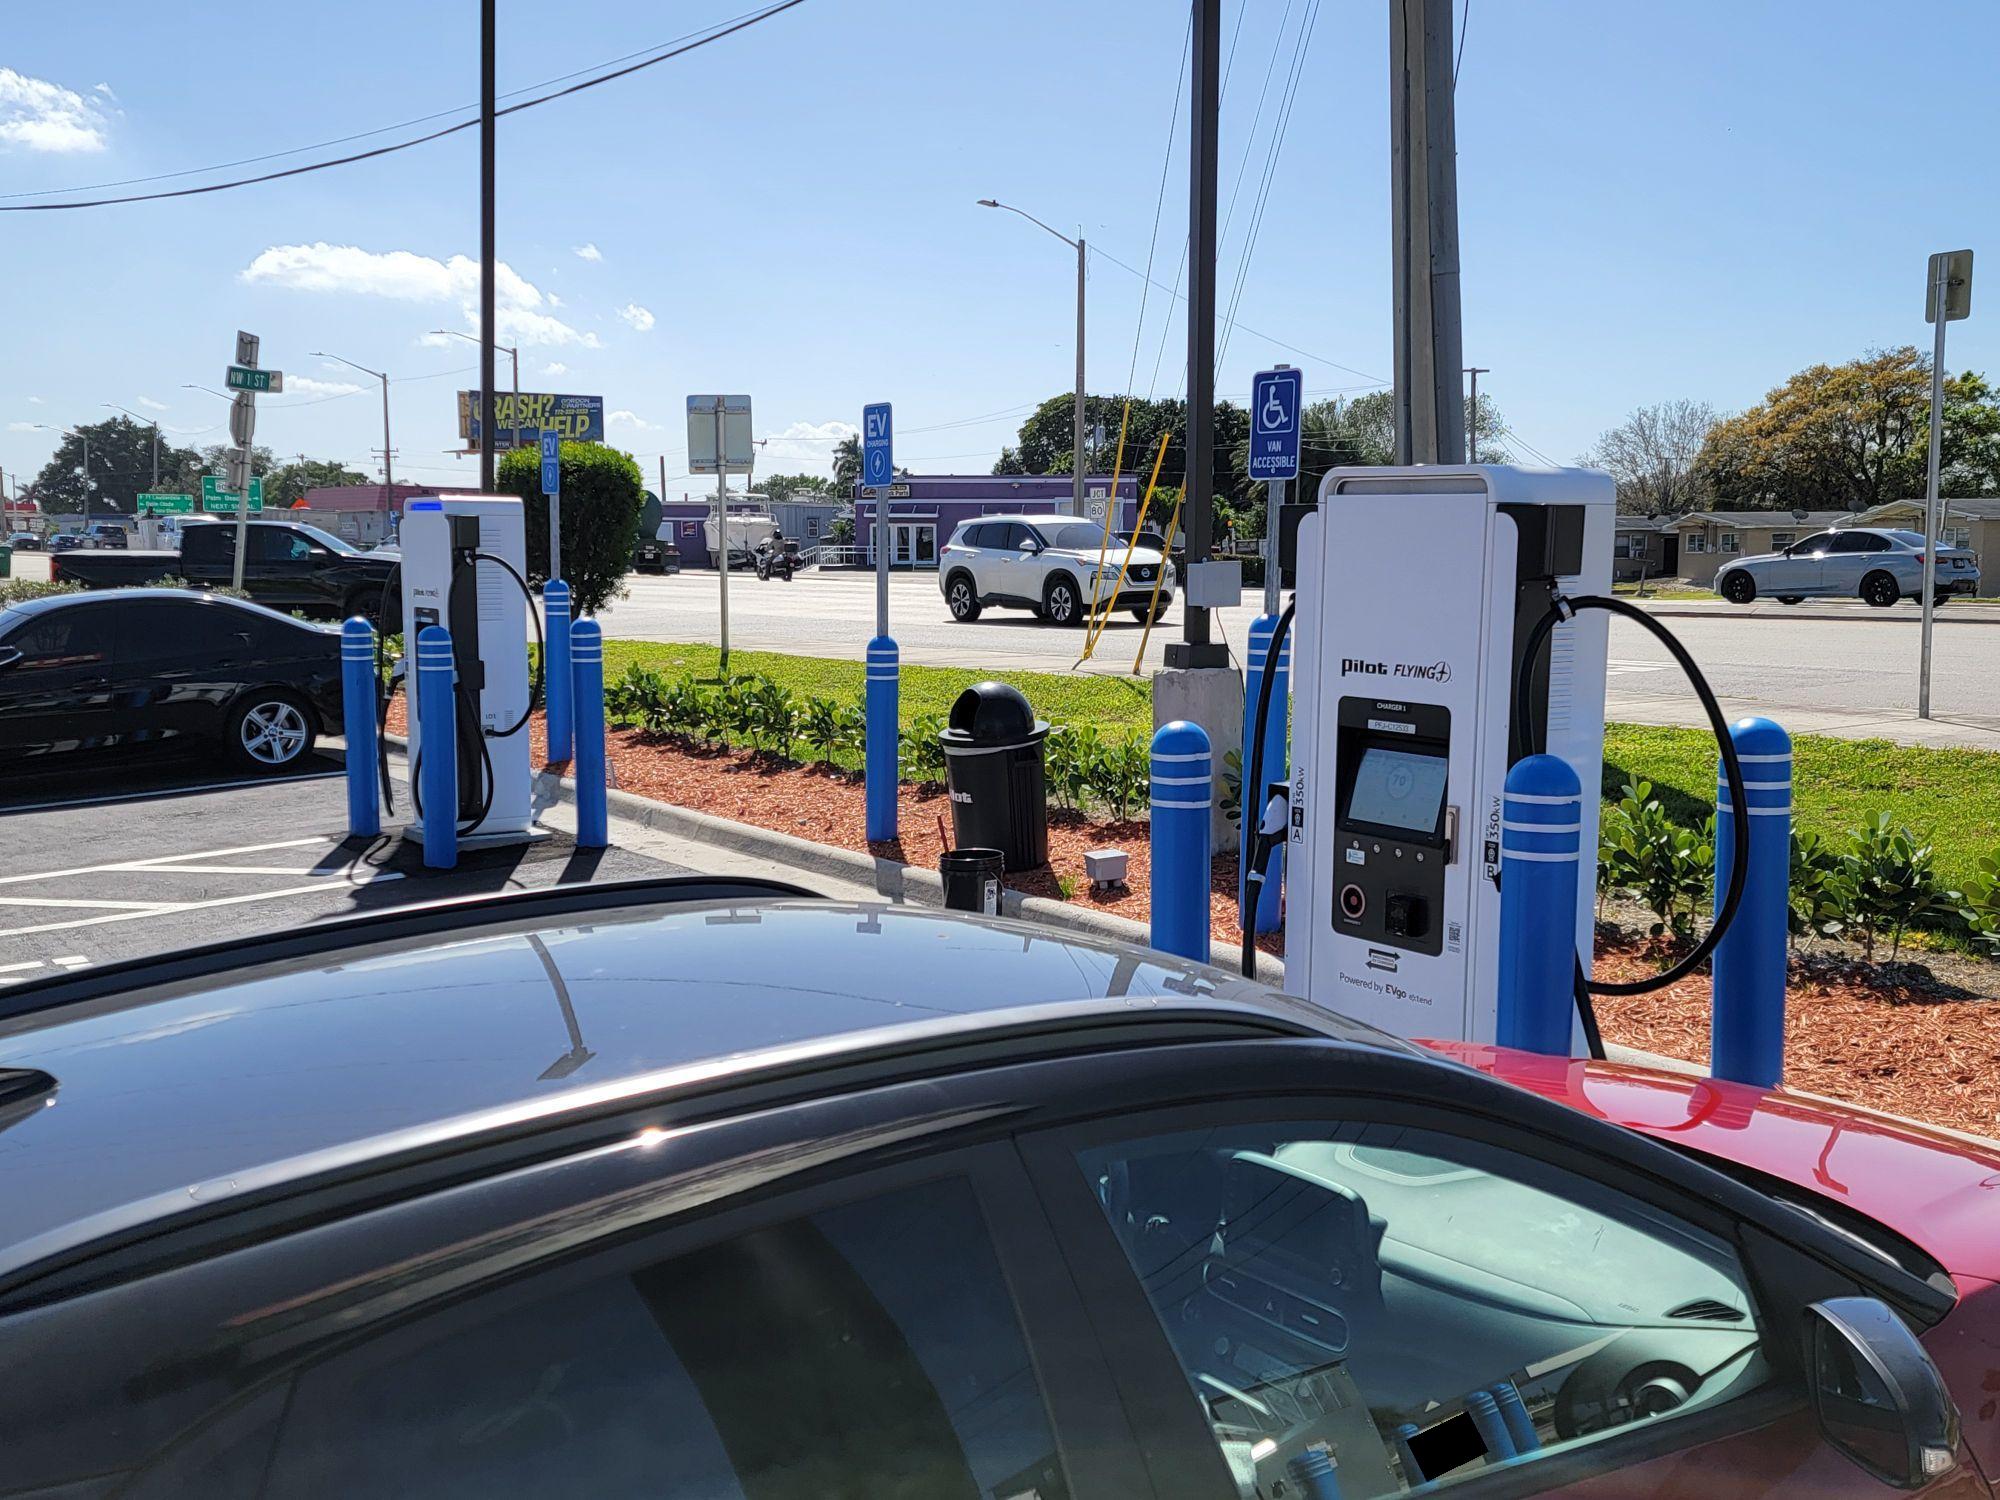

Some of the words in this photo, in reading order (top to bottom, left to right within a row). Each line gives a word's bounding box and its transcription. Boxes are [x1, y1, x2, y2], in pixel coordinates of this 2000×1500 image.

[230, 372, 242, 384] NW
[247, 374, 250, 386] 1
[254, 375, 265, 388] ST
[498, 419, 515, 429] WE
[518, 418, 540, 429] CAN
[540, 415, 590, 438] HELP
[868, 413, 887, 437] EV
[544, 437, 556, 456] EV
[1267, 440, 1282, 452] VAN
[1252, 455, 1295, 468] ACCESSIBLE
[1092, 489, 1104, 498] JCT
[1091, 506, 1103, 515] 80
[1393, 663, 1436, 680] FLYING
[1376, 702, 1402, 711] CHARGER
[1296, 767, 1304, 806] 350kW
[1489, 796, 1501, 840] 350kW
[1293, 829, 1301, 841] A
[1487, 865, 1495, 878] B
[1339, 971, 1373, 990] Powered
[1373, 981, 1384, 995] by
[1385, 984, 1407, 1000] EVgo
[1408, 994, 1433, 1006] extend
